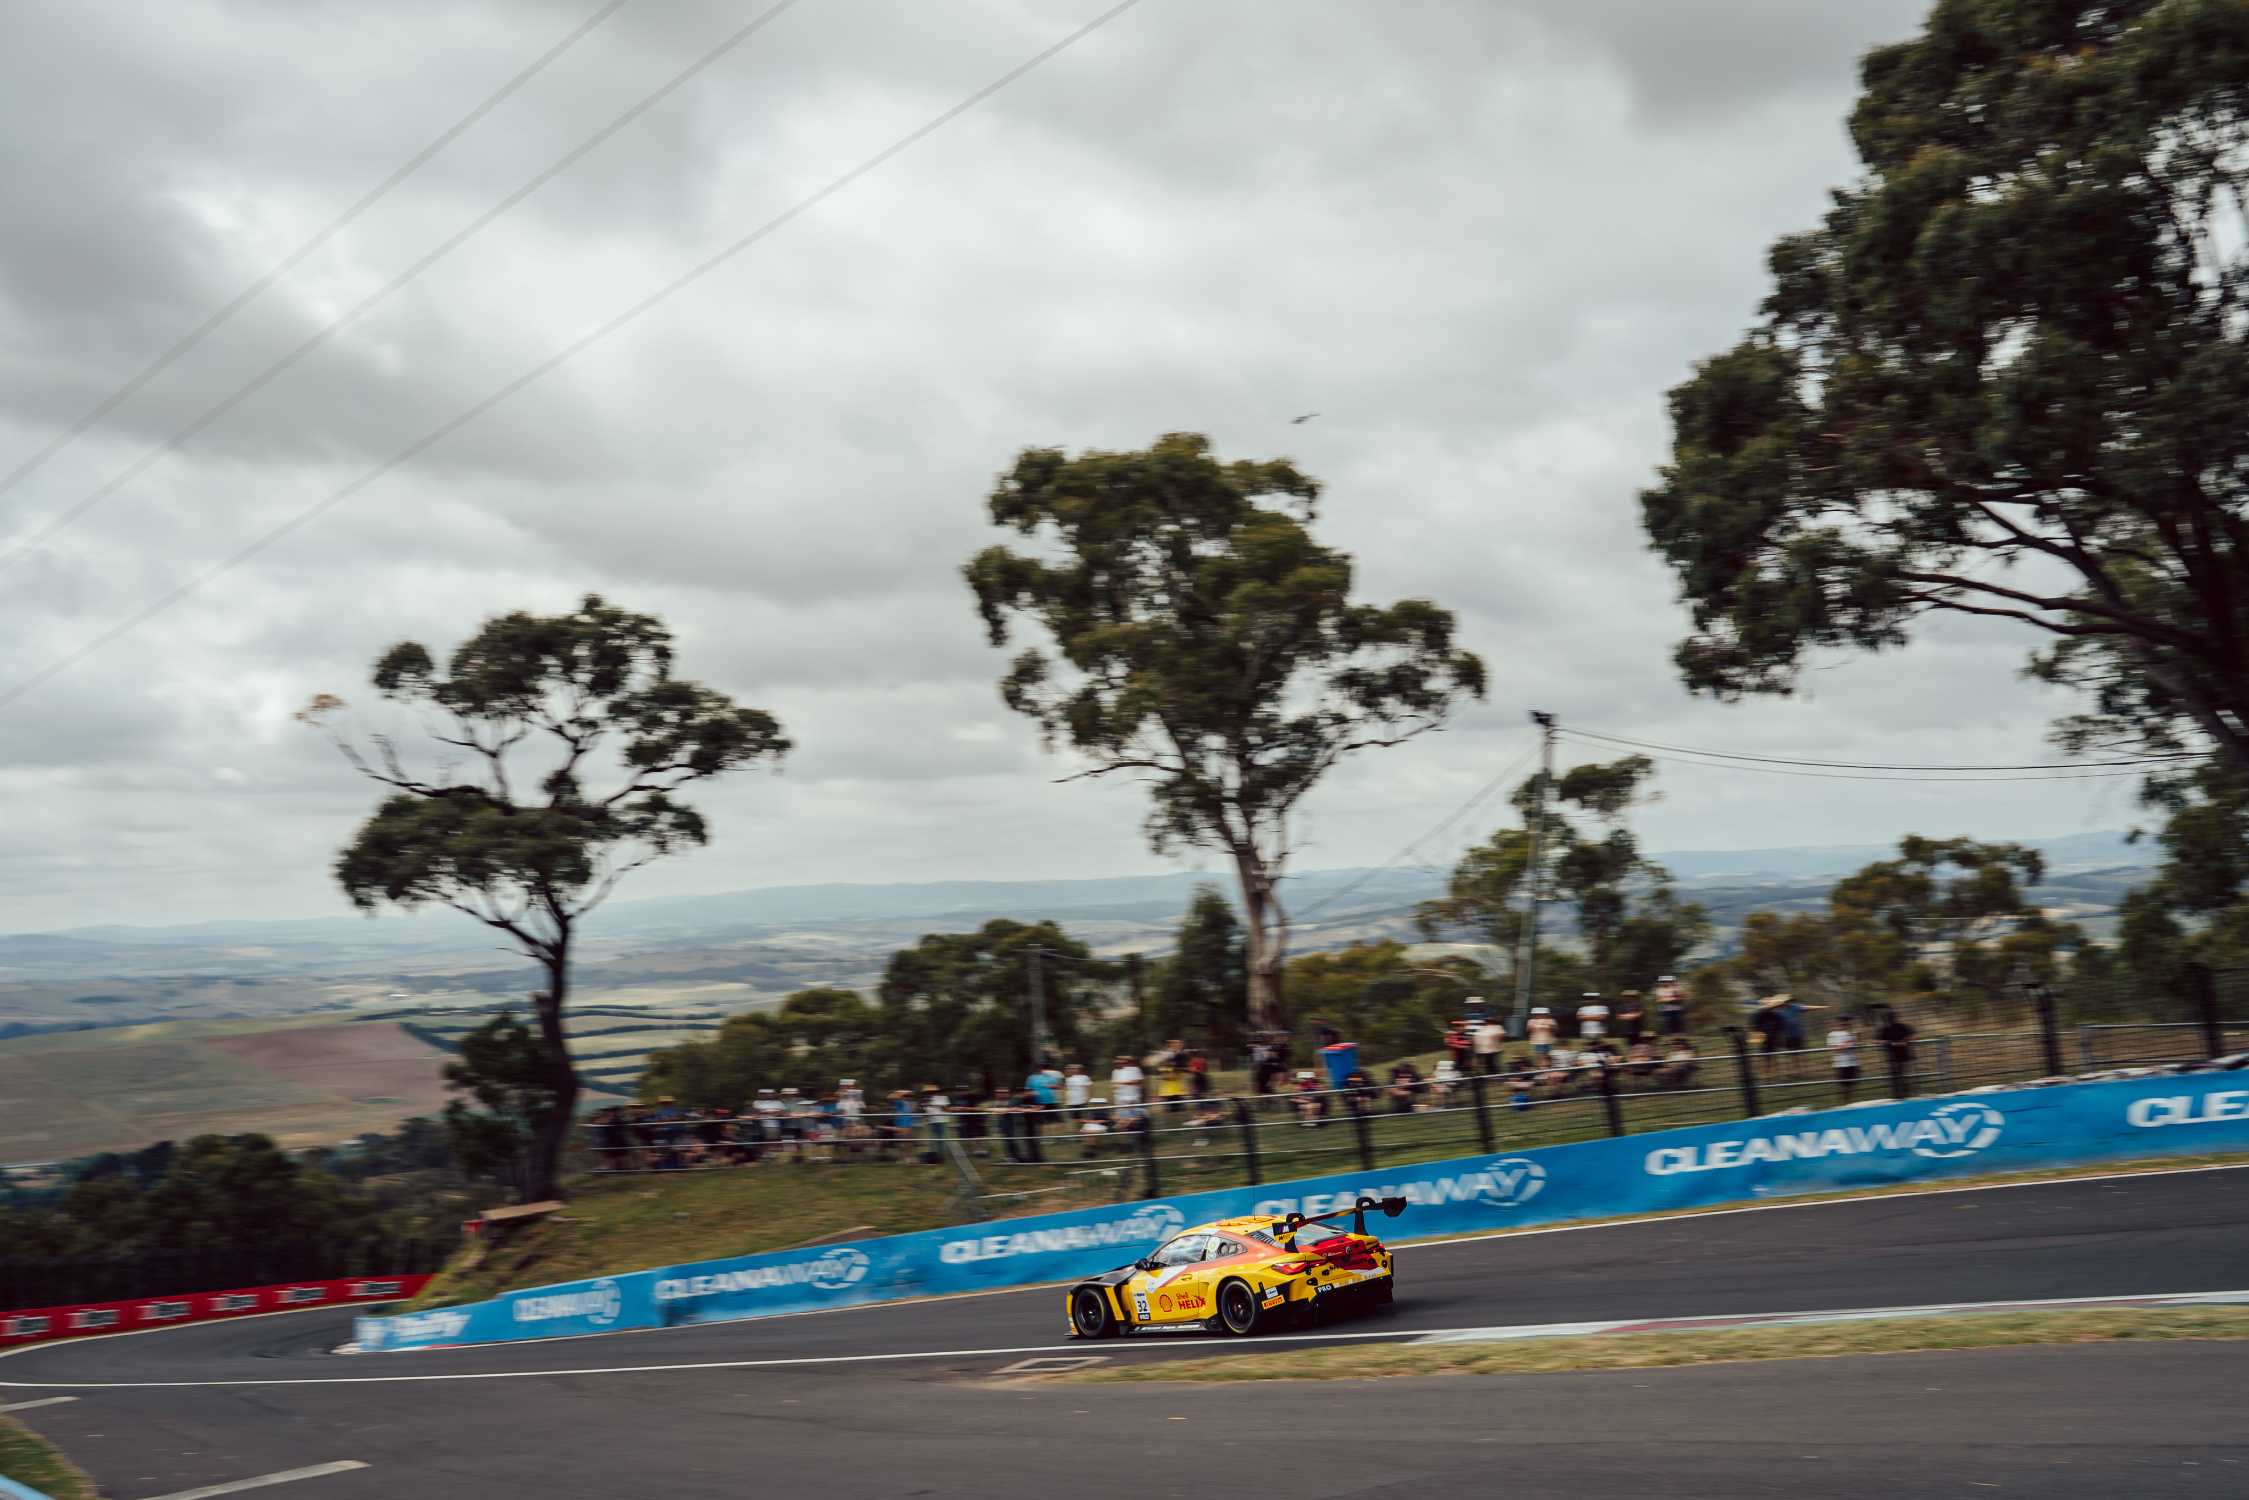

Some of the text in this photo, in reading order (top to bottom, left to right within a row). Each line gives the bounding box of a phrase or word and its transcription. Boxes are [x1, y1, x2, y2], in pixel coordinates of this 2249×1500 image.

[2127, 1090, 2249, 1127] CLE
[1644, 1113, 1982, 1175] CLEANAWAY
[655, 1257, 852, 1300] CLEANAWAY
[1317, 1285, 1332, 1293] PRO
[1137, 1301, 1148, 1312] 32
[1177, 1297, 1206, 1311] HELIX
